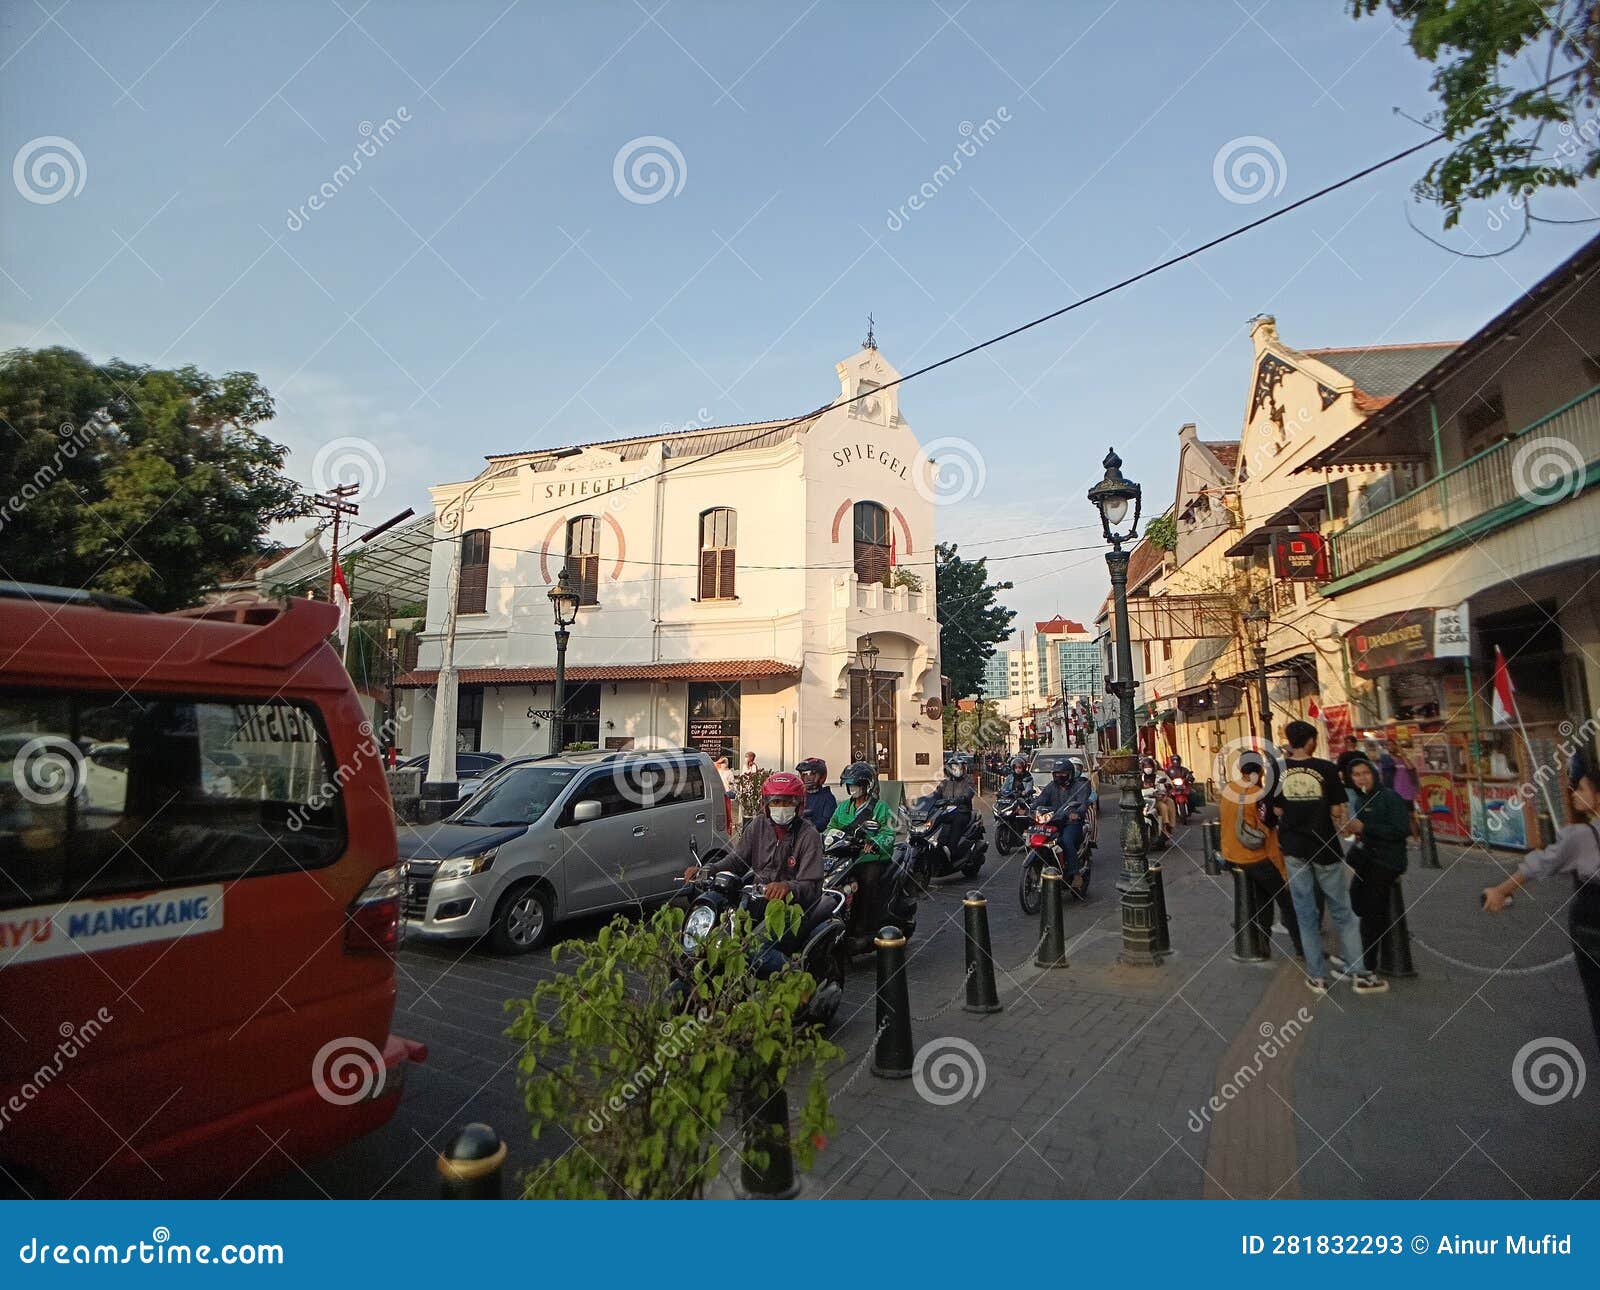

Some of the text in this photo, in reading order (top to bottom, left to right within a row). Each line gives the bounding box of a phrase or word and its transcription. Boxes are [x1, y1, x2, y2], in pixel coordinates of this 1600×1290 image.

[833, 443, 907, 481] SPIEGEL
[545, 477, 629, 499] SPIEGEL
[68, 896, 209, 938] MANGKANG
